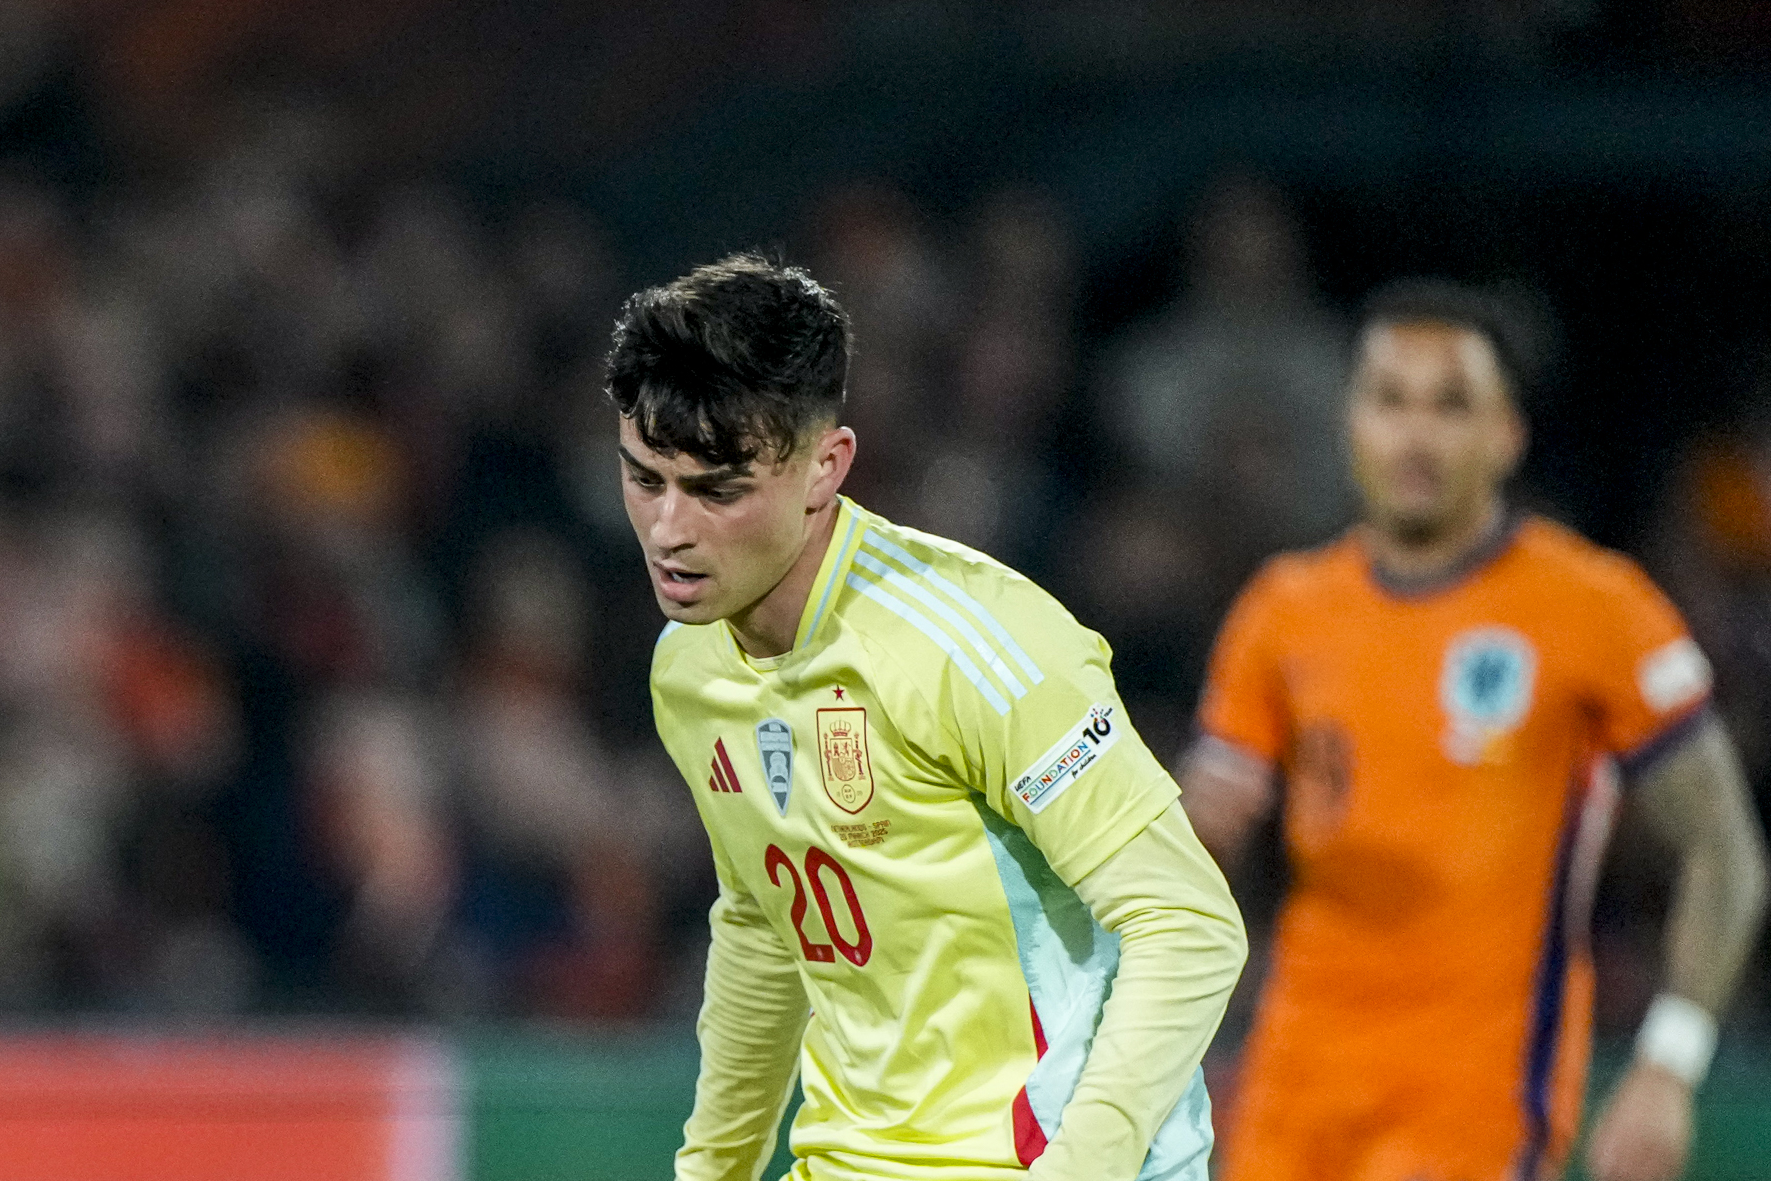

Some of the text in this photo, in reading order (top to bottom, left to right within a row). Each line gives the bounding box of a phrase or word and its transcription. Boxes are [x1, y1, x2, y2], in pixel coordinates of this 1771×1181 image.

[1082, 717, 1111, 745] 10
[1014, 775, 1032, 792] UEFA
[1022, 741, 1089, 803] FOUNDATION
[764, 843, 873, 967] 20
